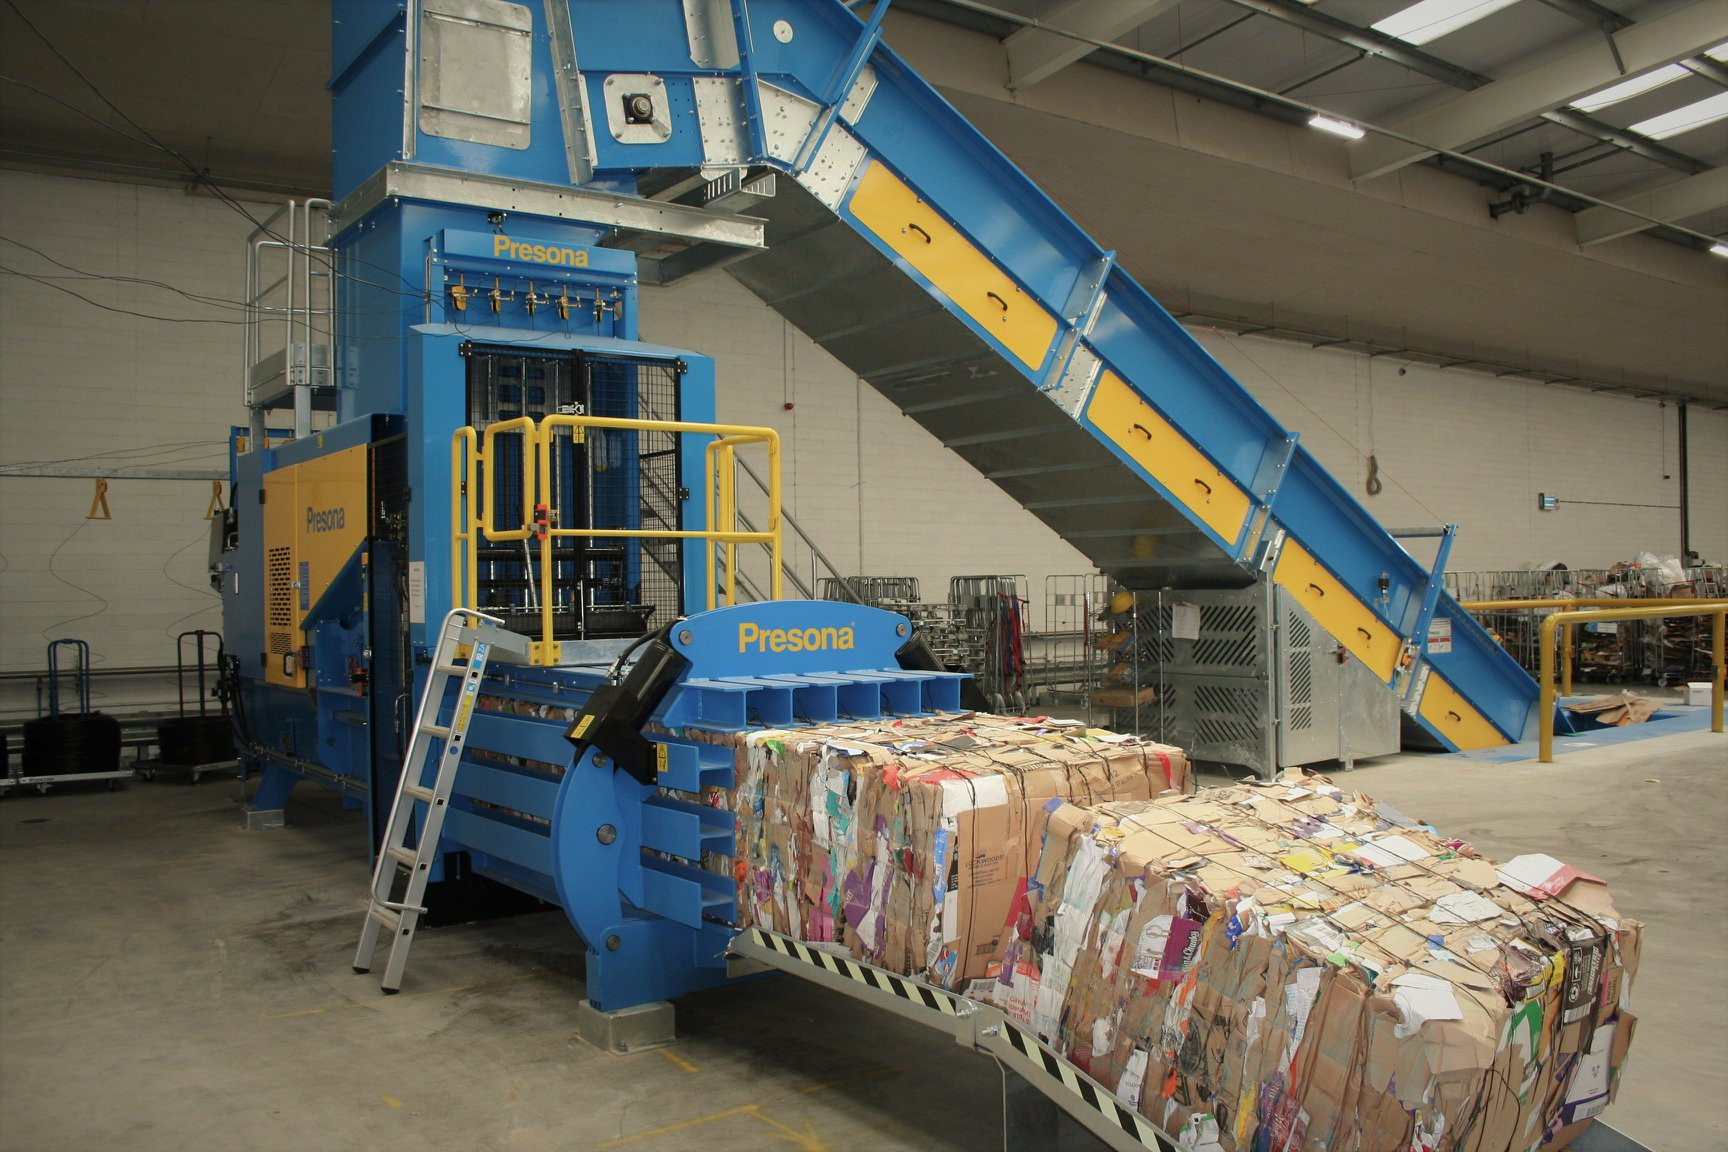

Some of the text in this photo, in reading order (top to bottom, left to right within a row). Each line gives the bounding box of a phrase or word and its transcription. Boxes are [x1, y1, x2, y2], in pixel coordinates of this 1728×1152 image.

[494, 235, 589, 268] Presona
[307, 506, 345, 533] Presona
[739, 622, 854, 653] Presona
[1183, 931, 1200, 955] Chunky
